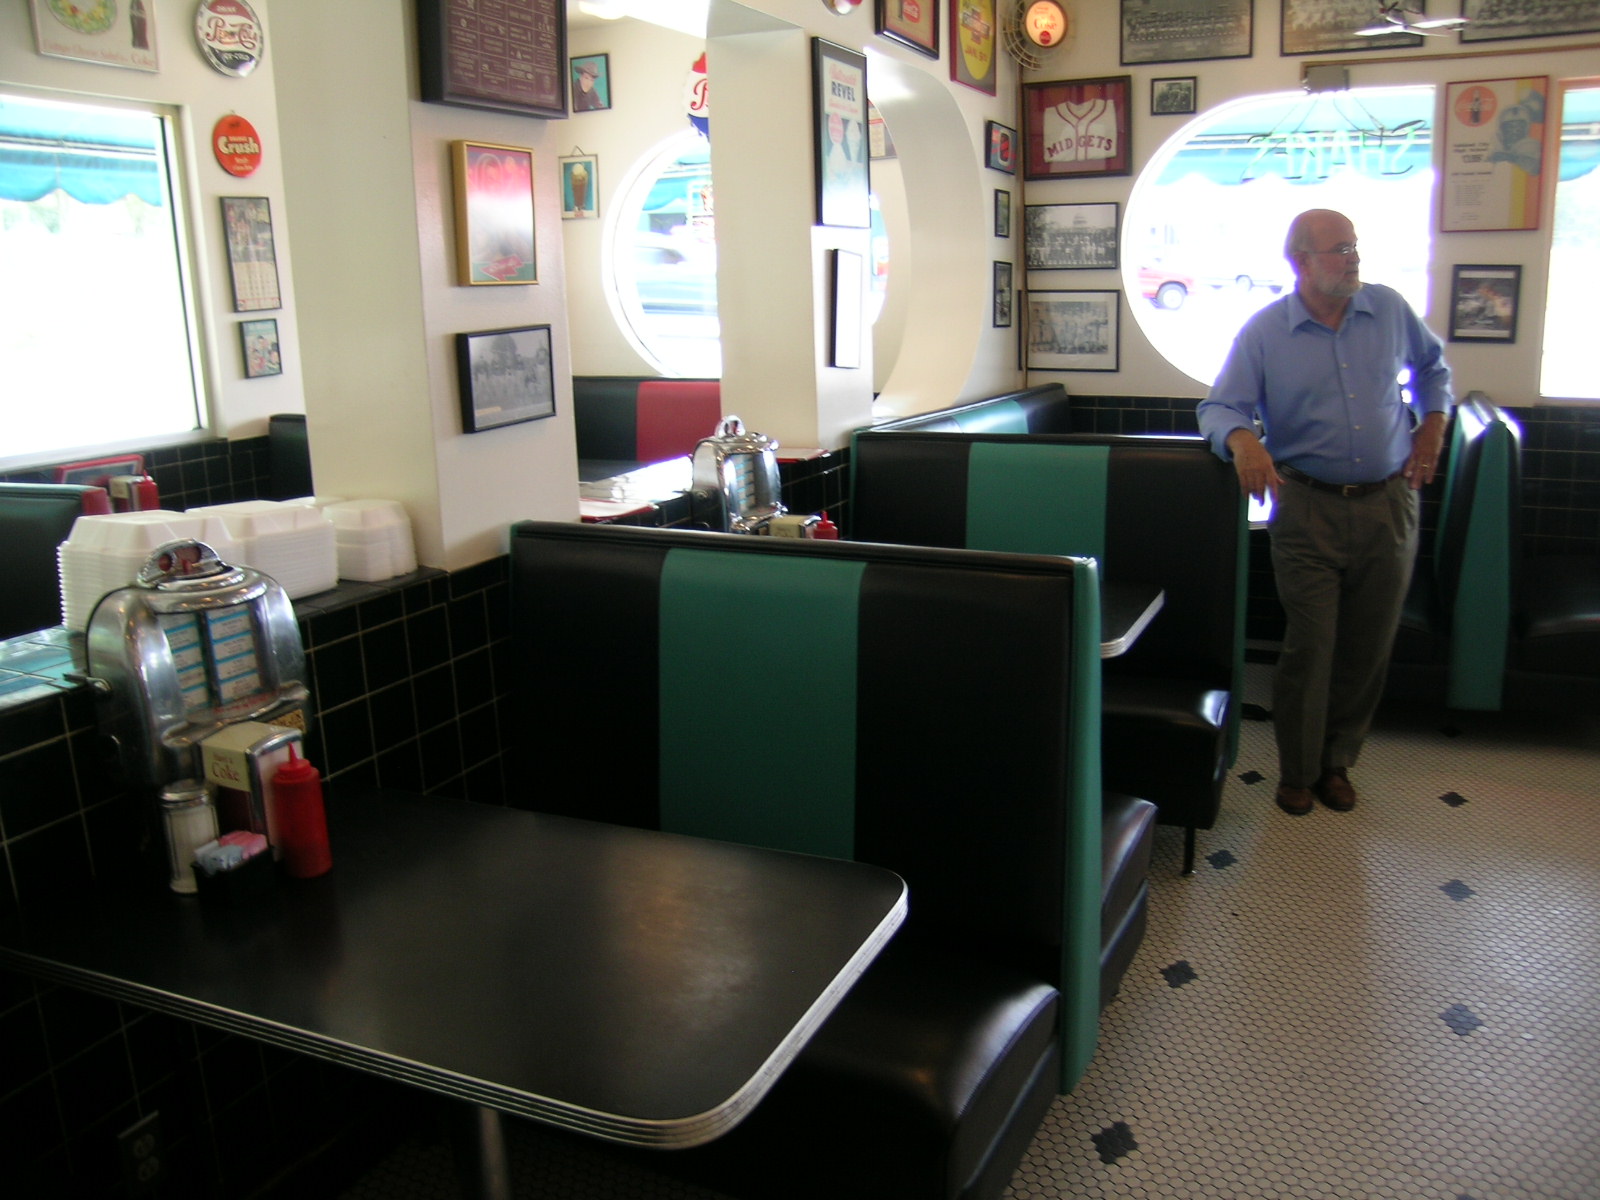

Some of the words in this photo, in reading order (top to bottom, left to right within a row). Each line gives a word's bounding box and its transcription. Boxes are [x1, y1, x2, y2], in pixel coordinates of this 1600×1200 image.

[831, 80, 856, 102] REVEL
[217, 135, 260, 155] Crush
[1046, 134, 1113, 158] MIDGETS
